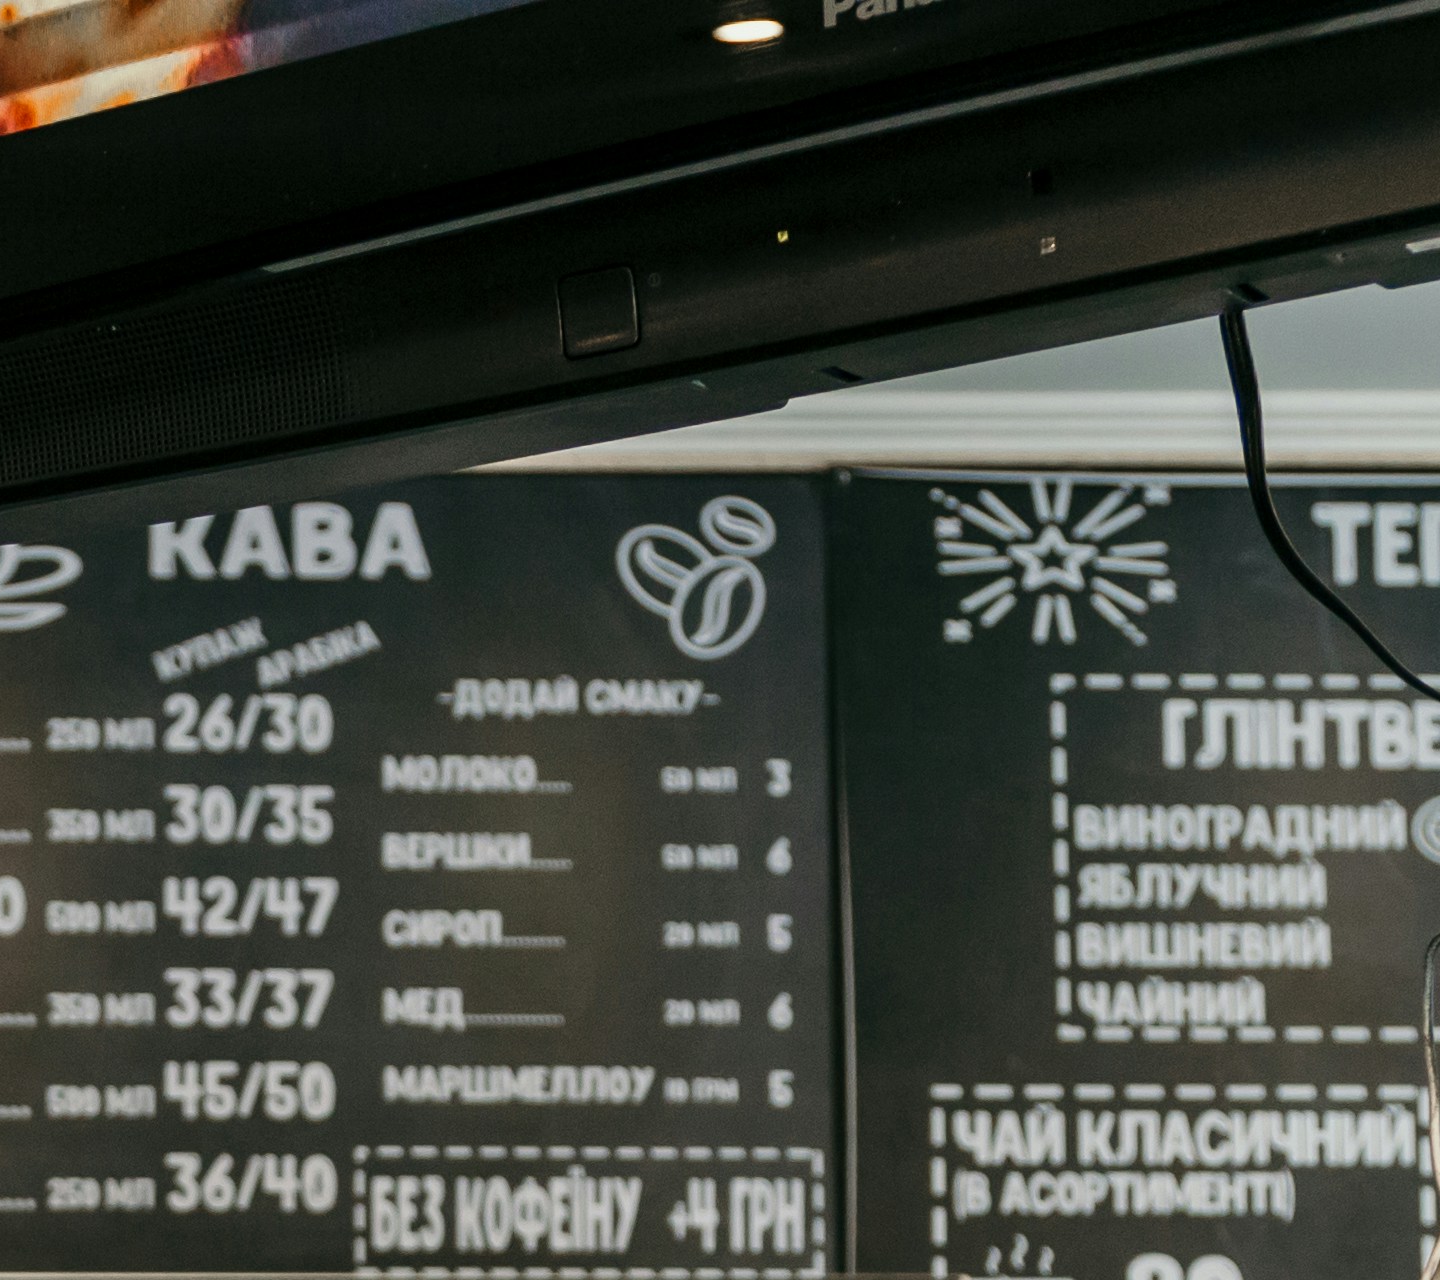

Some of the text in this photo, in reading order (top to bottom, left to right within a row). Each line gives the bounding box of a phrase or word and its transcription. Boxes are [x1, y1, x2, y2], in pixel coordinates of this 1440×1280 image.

[148, 501, 432, 581] КАВА
[163, 692, 335, 753] 26/30
[381, 755, 793, 798] МОЛОКО 3
[163, 784, 335, 844] 30/35
[1073, 802, 1408, 856] ВИНОГРАДНИЙ
[381, 831, 793, 876] ВЕРШКИ 6
[163, 876, 339, 938] 42/47
[1077, 861, 1328, 910] ЯБЛУЧНИЙ
[381, 909, 794, 953] СИРОП 5
[1075, 919, 1332, 970] ВИШНЕВИЙ
[163, 966, 336, 1029] 33/37
[381, 987, 795, 1030] МЕД 6
[1075, 977, 1268, 1027] ЧАЙНИЙ
[163, 1059, 337, 1122] 45/50
[767, 1069, 795, 1109] 5
[952, 1100, 1417, 1170] ЧАЙ КЛАСИЧНИЙ
[163, 1150, 339, 1214] 36/40
[370, 1174, 446, 1253] БЕЗ
[668, 1176, 719, 1253] +4
[729, 1174, 806, 1254] ГРН
